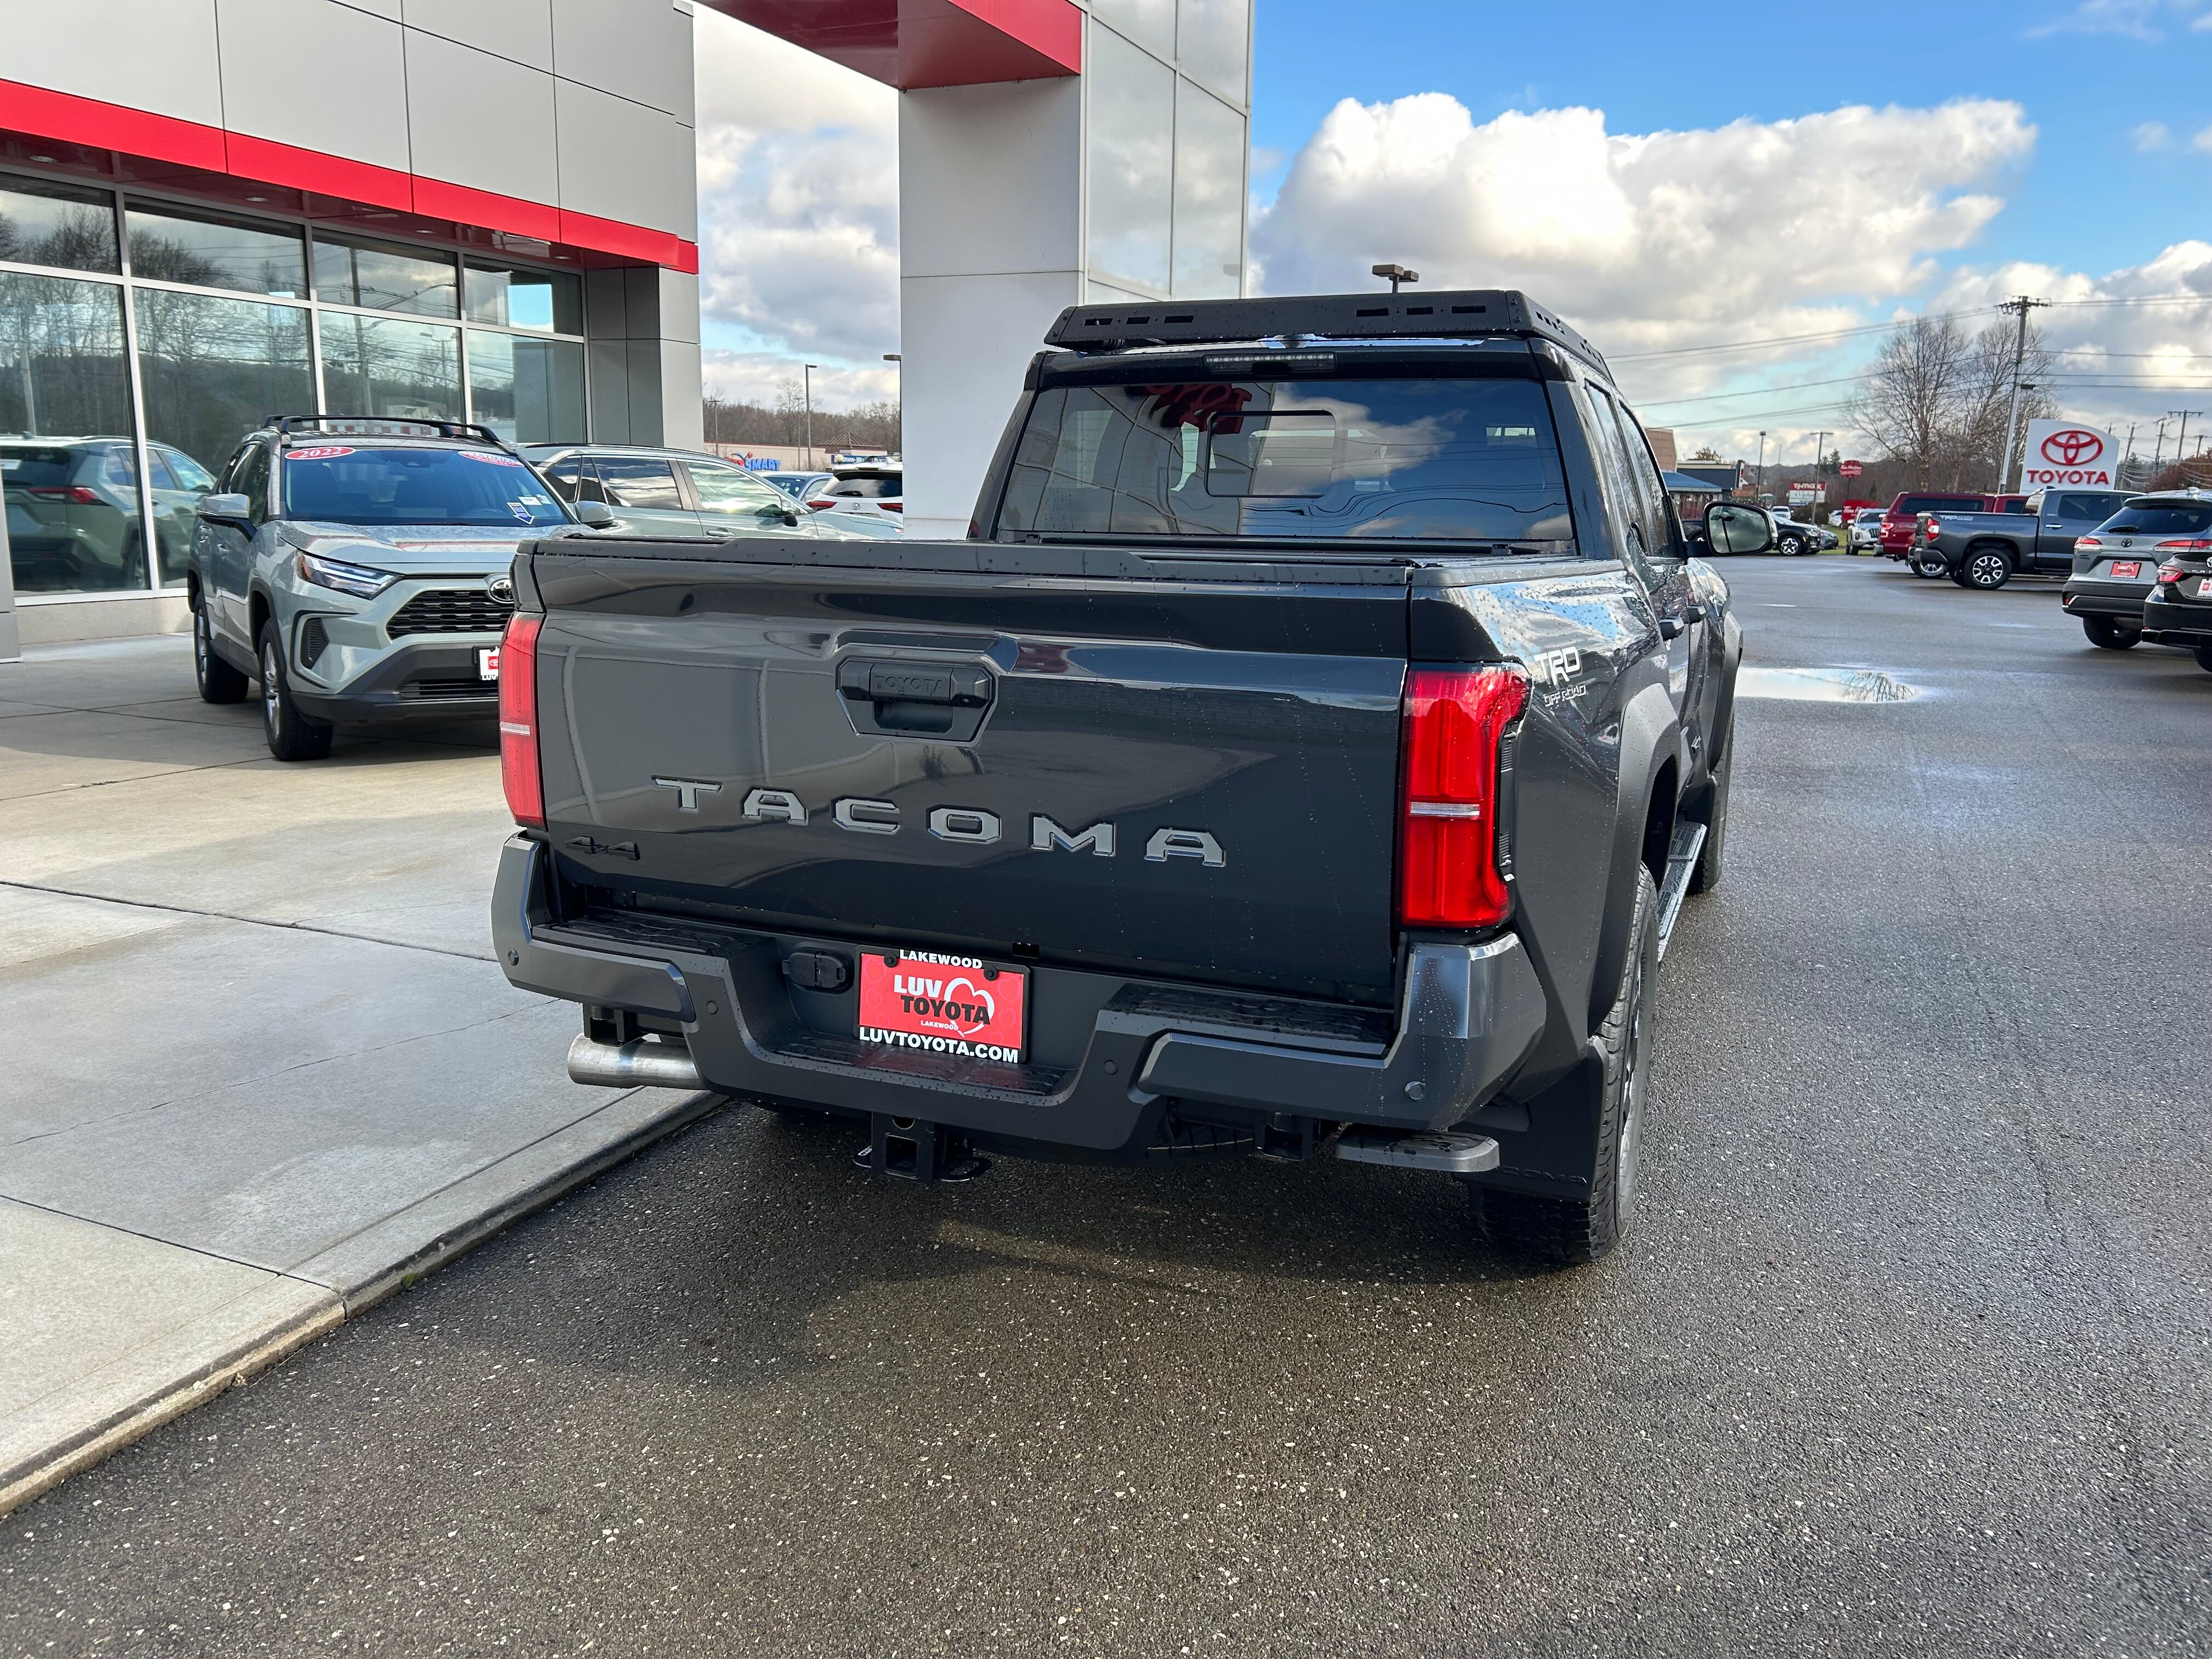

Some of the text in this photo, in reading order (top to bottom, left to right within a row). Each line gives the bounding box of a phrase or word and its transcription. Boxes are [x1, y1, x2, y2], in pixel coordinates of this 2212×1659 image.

[298, 448, 343, 458] 2022
[2027, 470, 2109, 484] TOYOTA
[1533, 646, 1581, 685] TRD
[874, 675, 946, 695] TOYOTA
[652, 775, 1225, 867] TACOMA
[900, 949, 983, 969] LAKEWOOD
[894, 974, 943, 998] LUV
[901, 995, 990, 1025] TOYOTA
[921, 1020, 959, 1031] LAKEWOOD
[859, 1027, 1018, 1063] LUVTOYOTA.COM
